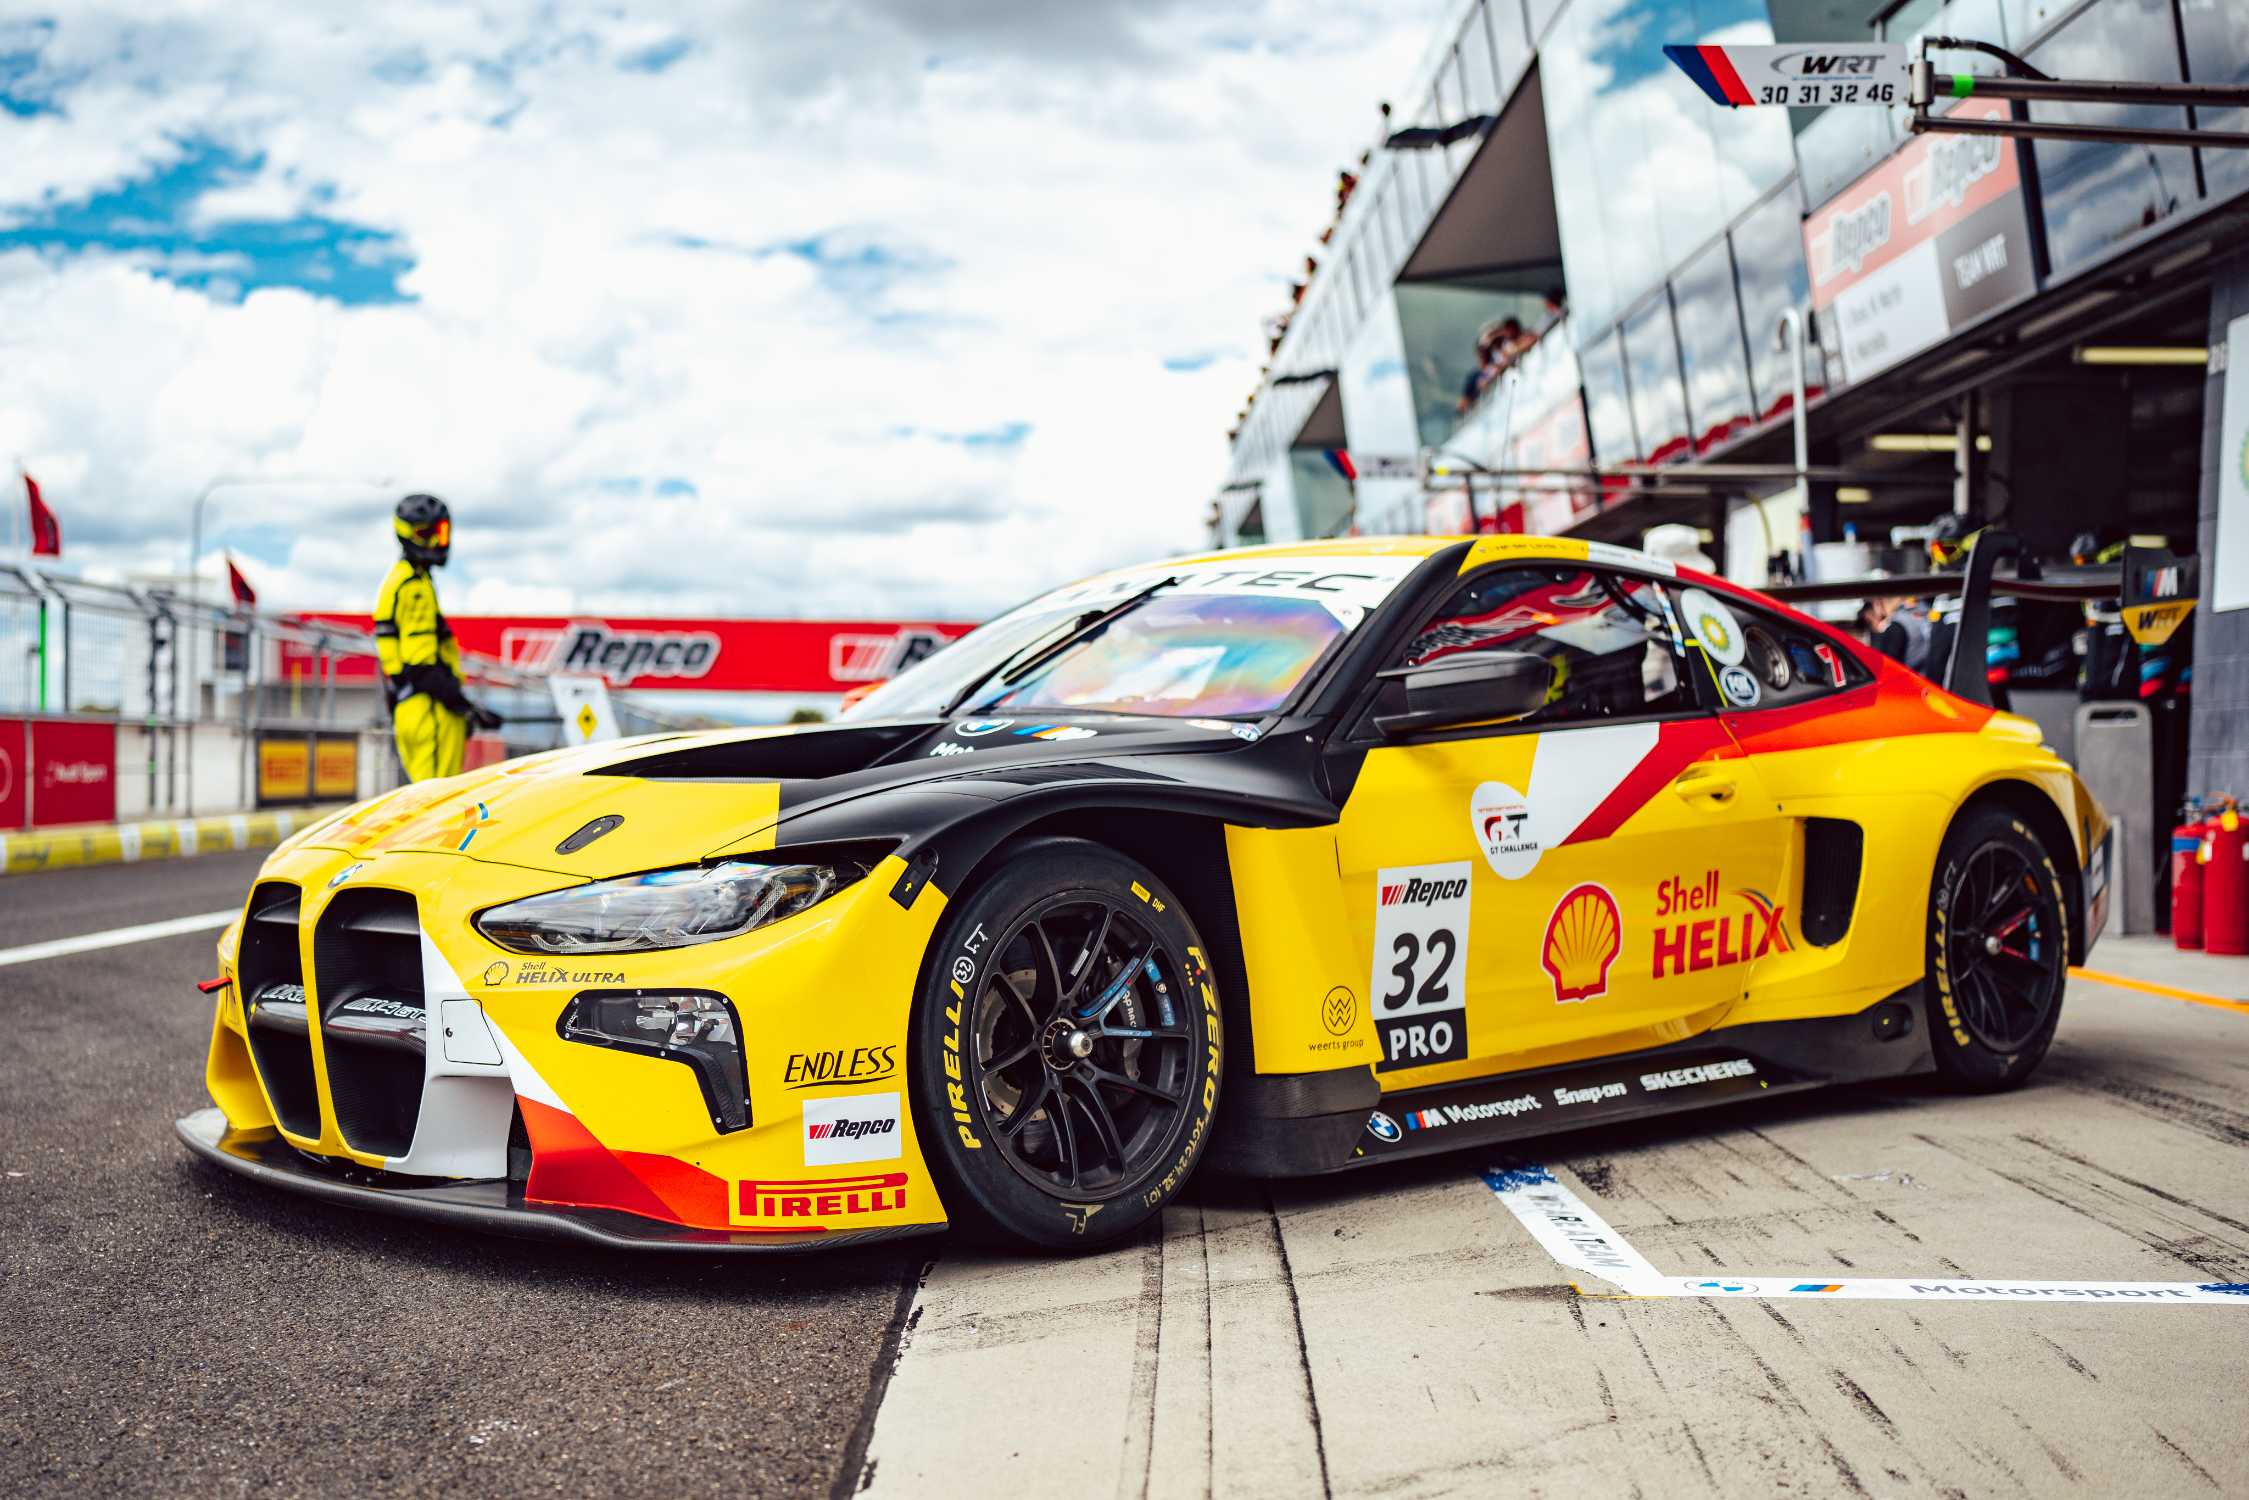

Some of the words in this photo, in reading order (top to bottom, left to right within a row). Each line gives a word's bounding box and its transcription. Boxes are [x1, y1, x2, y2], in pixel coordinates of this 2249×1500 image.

[1802, 55, 1886, 74] WRT
[1761, 86, 1789, 105] 30
[1798, 85, 1820, 103] 31
[1830, 84, 1858, 103] 32
[1866, 83, 1894, 102] 46
[565, 630, 710, 674] Repco
[1501, 842, 1538, 854] CHALLENGE
[1402, 878, 1467, 907] Repco
[1656, 869, 1719, 916] Shell
[1652, 904, 1790, 979] HELIX
[516, 969, 569, 984] HELIX
[572, 972, 625, 984] ULTRA
[522, 962, 546, 971] Shell
[1383, 928, 1456, 1010] 32
[1187, 946, 1206, 970] P
[1200, 982, 1219, 1114] ZERO
[1308, 1039, 1341, 1052] weerts
[1342, 1038, 1364, 1051] group
[1389, 1021, 1453, 1061] PRO
[784, 1045, 897, 1083] ENDLESS
[944, 979, 982, 1149] PIRELLI
[1640, 1058, 1756, 1091] SKECHERS
[1443, 1094, 1543, 1123] Motorsport
[830, 1118, 895, 1140] Repco
[739, 1172, 909, 1217] PIRELLI
[1909, 1284, 2192, 1298] Motorsport
